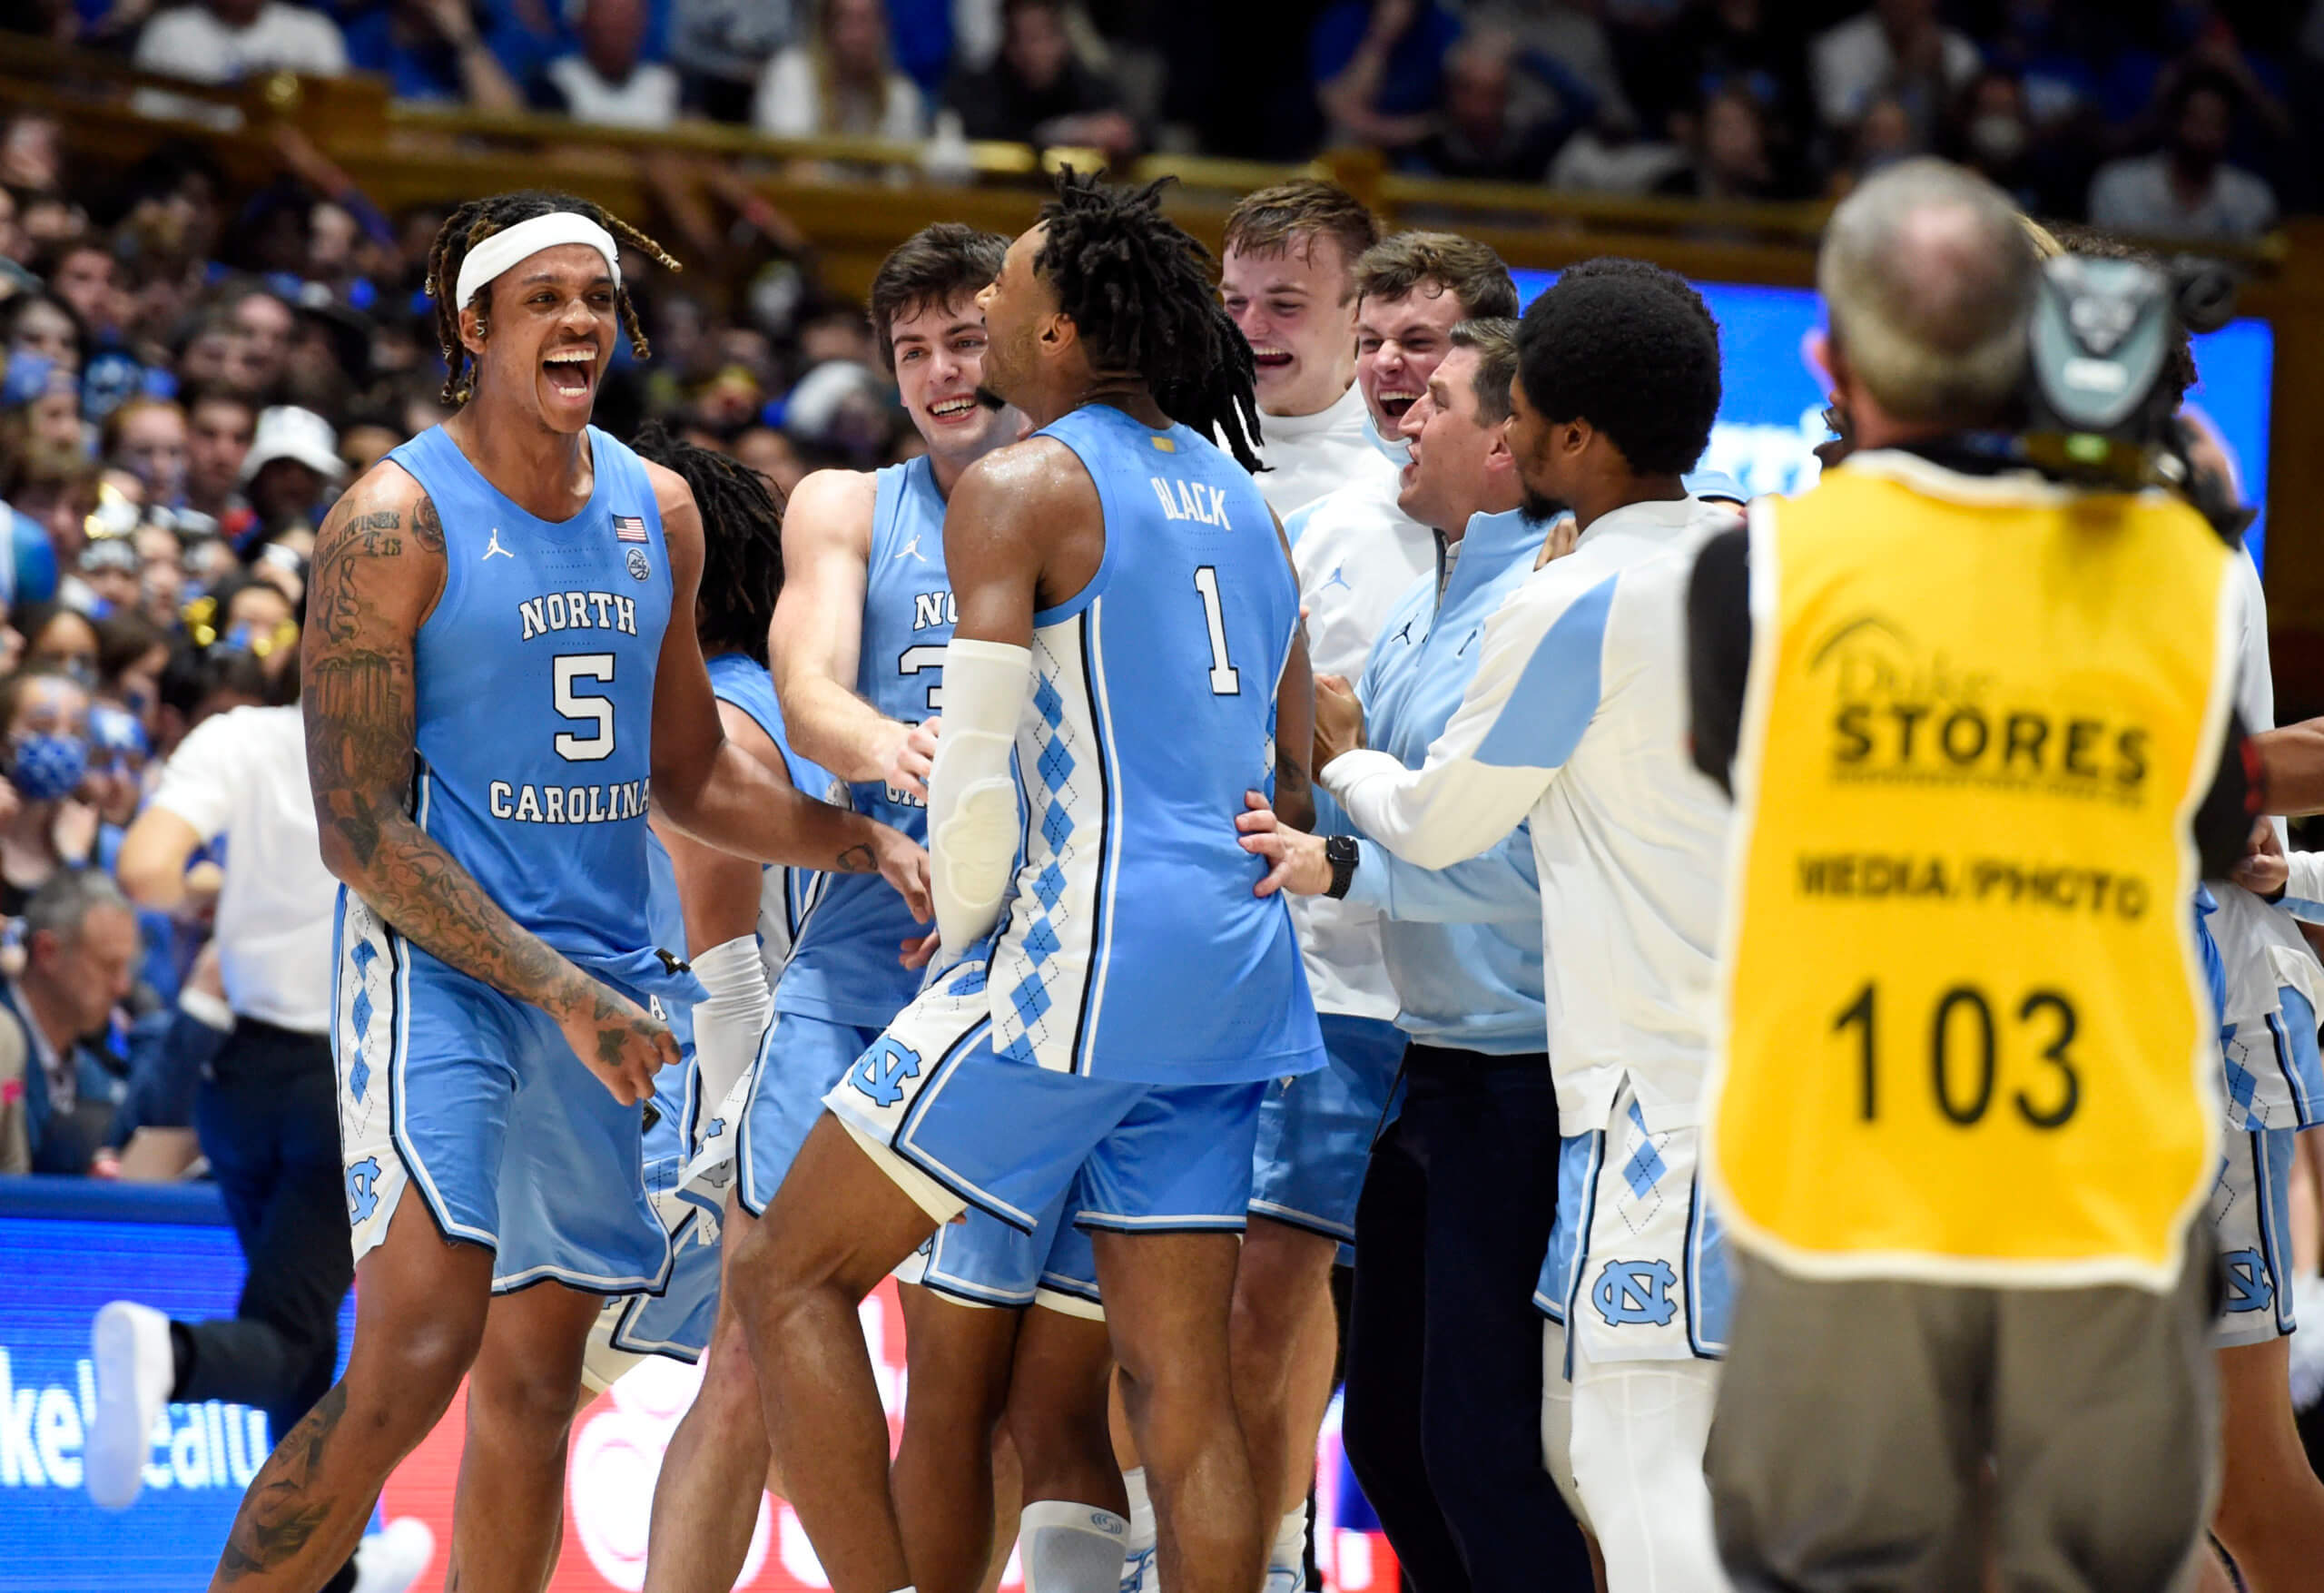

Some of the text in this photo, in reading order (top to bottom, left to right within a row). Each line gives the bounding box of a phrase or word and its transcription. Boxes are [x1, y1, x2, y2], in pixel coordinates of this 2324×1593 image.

[1150, 477, 1232, 530] BLACK
[518, 591, 638, 642] NORTH
[1194, 565, 1241, 696] 1
[552, 653, 615, 762] 5
[1836, 703, 2152, 786] STORES
[489, 777, 651, 824] CAROLINA
[1833, 978, 2081, 1129] 103
